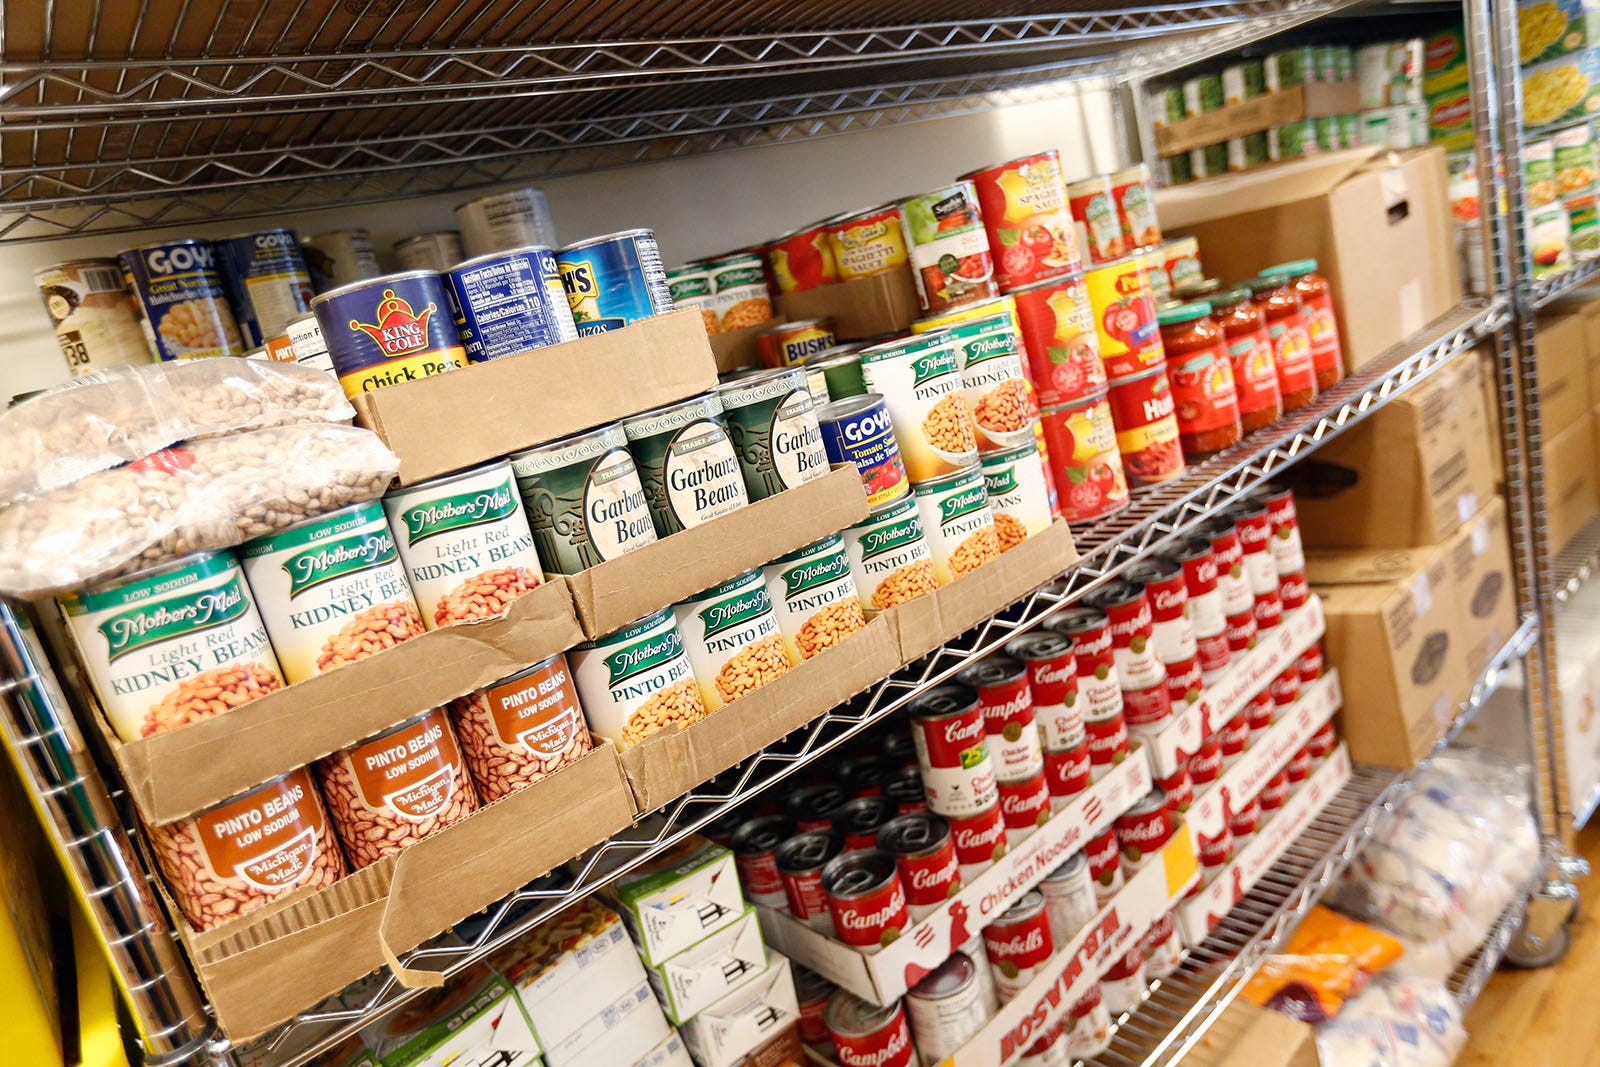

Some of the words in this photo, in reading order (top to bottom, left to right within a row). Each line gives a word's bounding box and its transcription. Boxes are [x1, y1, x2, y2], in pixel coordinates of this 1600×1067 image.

[852, 258, 885, 273] SAUCE
[524, 297, 540, 311] 110
[381, 322, 421, 343] KING
[386, 335, 424, 354] COLE
[362, 367, 417, 393] Chick
[423, 359, 463, 379] Peas
[915, 380, 953, 400] PINTO
[963, 369, 1011, 389] KIDNEY
[844, 407, 892, 441] GOYA
[682, 438, 706, 452] TRADER
[851, 443, 883, 460] Tomato
[670, 455, 739, 492] Garbanzo
[857, 457, 875, 469] alsa
[874, 452, 885, 463] de
[693, 481, 739, 511] Beans
[412, 500, 477, 535] Mother's
[474, 488, 511, 519] Maid
[876, 512, 890, 522] LOW
[309, 527, 333, 540] LOW
[335, 515, 367, 533] SODIUM
[866, 526, 911, 552] Mother's
[942, 517, 982, 538] PINTO
[435, 537, 478, 560] Light
[483, 525, 511, 545] Red
[801, 547, 816, 557] LOW
[296, 543, 368, 584] Mother's
[412, 552, 482, 583] KIDNEY
[489, 532, 534, 562] BEANS
[864, 553, 908, 574] PINTO
[124, 588, 150, 602] LOW
[153, 572, 199, 593] SODIUM
[329, 577, 369, 601] Light
[374, 567, 395, 585] Red
[720, 583, 735, 594] LOW
[790, 561, 837, 590] Mother's
[290, 590, 375, 630] KIDNEY
[380, 574, 410, 601] BEA
[709, 598, 758, 630] Mother's
[788, 590, 834, 613] PINTO
[111, 604, 198, 649] Mother's
[194, 585, 242, 625] Maid
[149, 641, 198, 667] Light
[206, 625, 235, 646] Red
[625, 627, 641, 639] LOW
[706, 629, 756, 655] PINTO
[111, 655, 203, 696] KIDNEY
[214, 626, 267, 666] BEANS
[614, 641, 667, 677] Mother's
[501, 686, 538, 711] PINTO
[538, 670, 566, 696] BEANS
[611, 675, 665, 703] PINTO
[518, 703, 538, 719] LOW
[539, 690, 565, 713] SODIUM
[528, 719, 573, 744] Michigan
[543, 734, 567, 752] Made
[366, 744, 407, 771] PINTO
[408, 724, 443, 754] BEANS
[385, 763, 408, 781] LOW
[409, 747, 440, 772] SODIUM
[397, 778, 449, 807] Michigan
[411, 795, 443, 815] Made
[214, 808, 262, 840] PINTO
[263, 784, 304, 819] BEANS
[236, 831, 262, 848] LOW
[264, 808, 301, 836] SODIUM
[250, 842, 312, 876] Michigan
[266, 860, 304, 884] Made
[980, 864, 1035, 916] Chicken
[1035, 826, 1080, 871] Noodle
